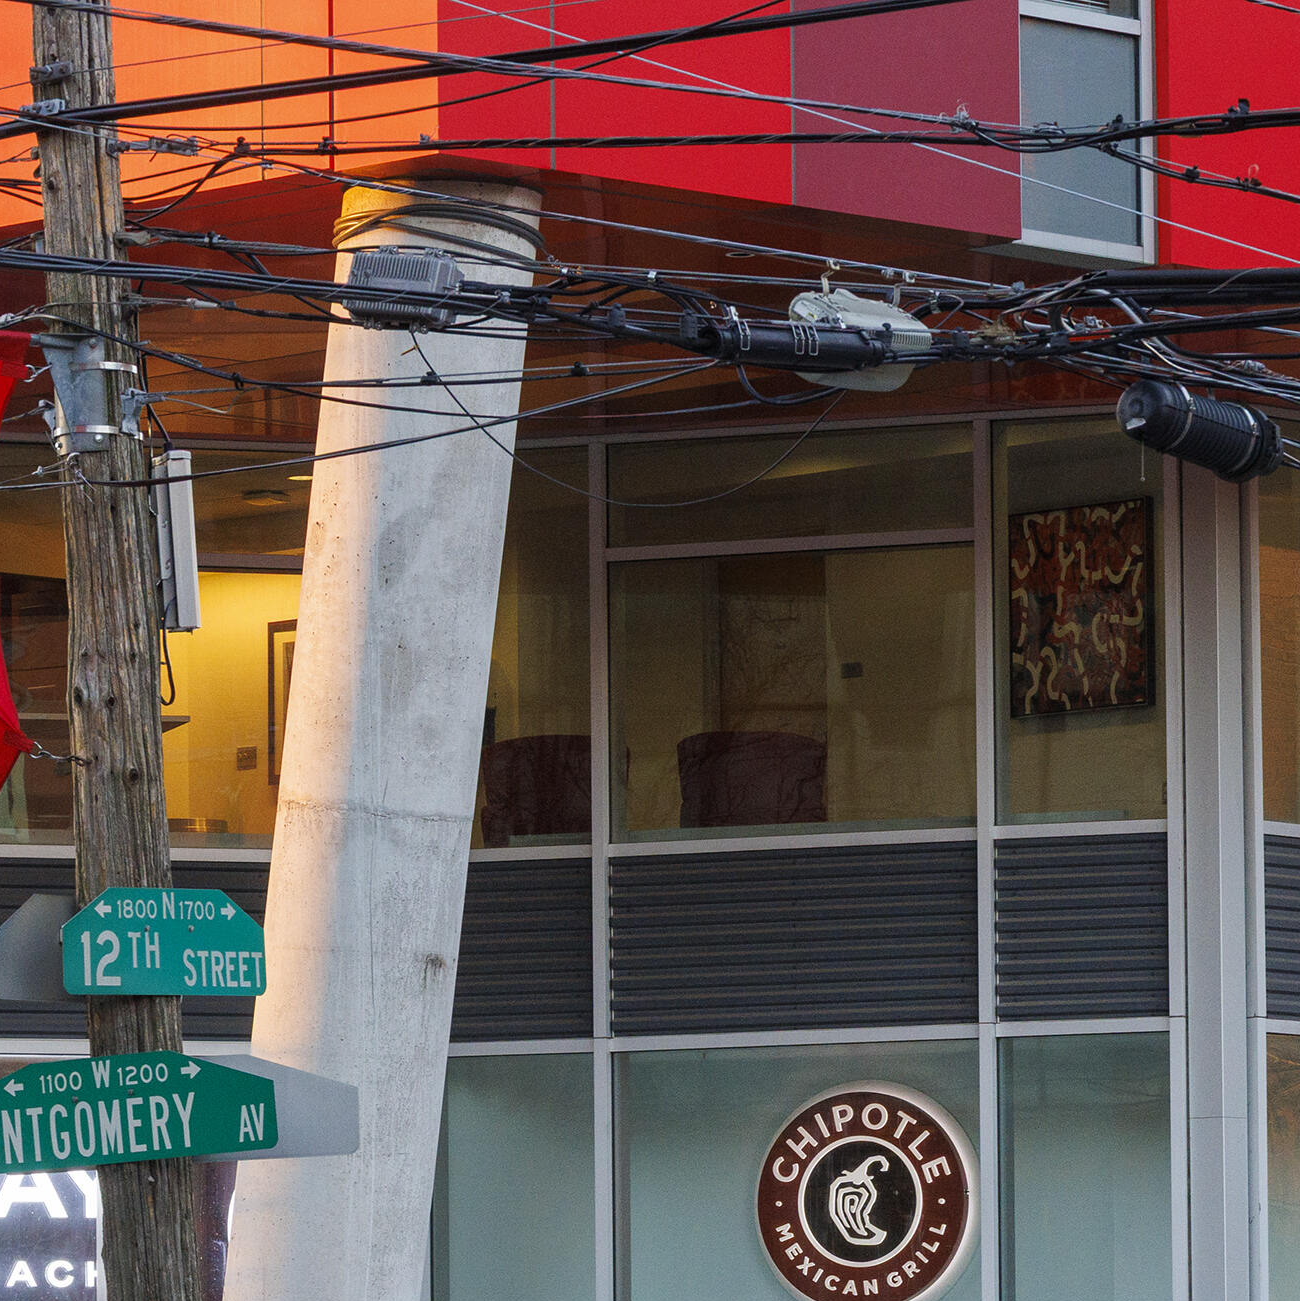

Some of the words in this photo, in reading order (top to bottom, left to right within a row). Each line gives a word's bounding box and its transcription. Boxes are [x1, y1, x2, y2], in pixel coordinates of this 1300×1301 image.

[117, 900, 157, 919] 1800
[162, 892, 175, 919] N
[179, 901, 215, 920] 1700
[183, 949, 263, 988] STREET
[39, 1072, 82, 1094] 1100
[91, 1060, 110, 1088] W
[116, 1063, 169, 1086] 1200
[239, 1103, 265, 1143] AV
[772, 1103, 951, 1184] CHIPOTLE
[775, 1223, 879, 1295] MEXICAN
[887, 1223, 947, 1287] GRILL
